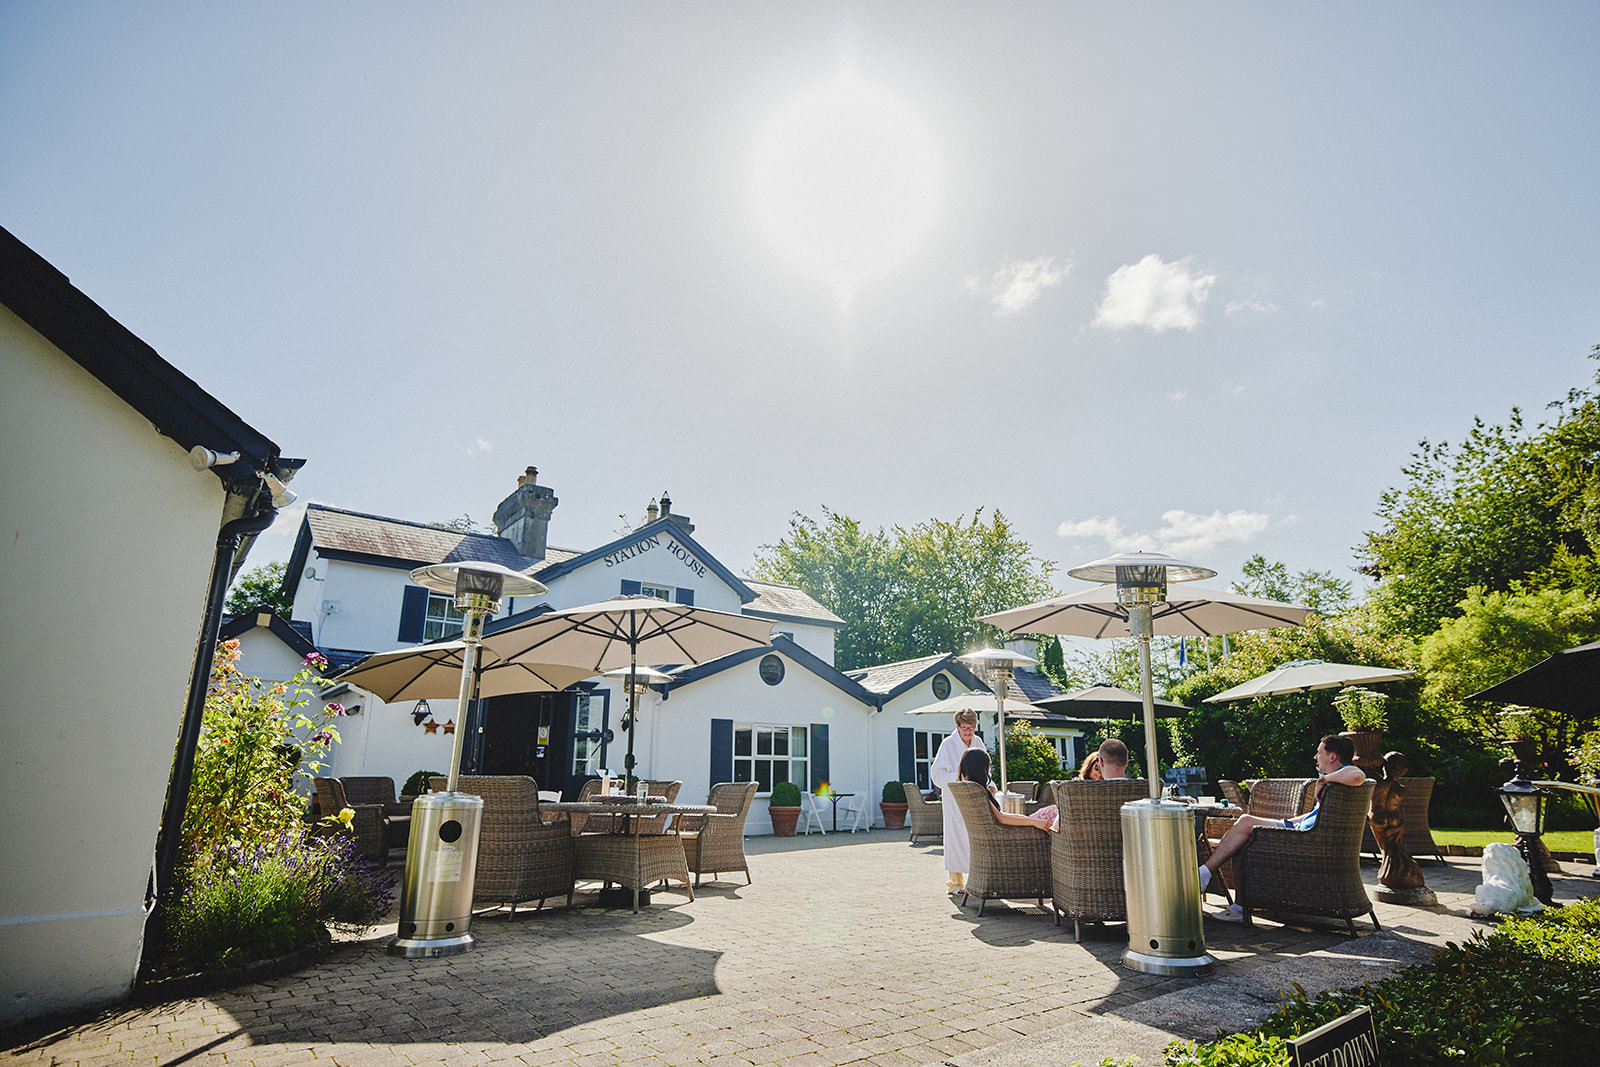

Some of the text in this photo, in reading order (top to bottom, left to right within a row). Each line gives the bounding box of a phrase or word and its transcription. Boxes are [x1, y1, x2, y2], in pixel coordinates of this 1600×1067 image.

[604, 535, 707, 578] STATION HOUSE
[1332, 1030, 1376, 1067] DOWN
